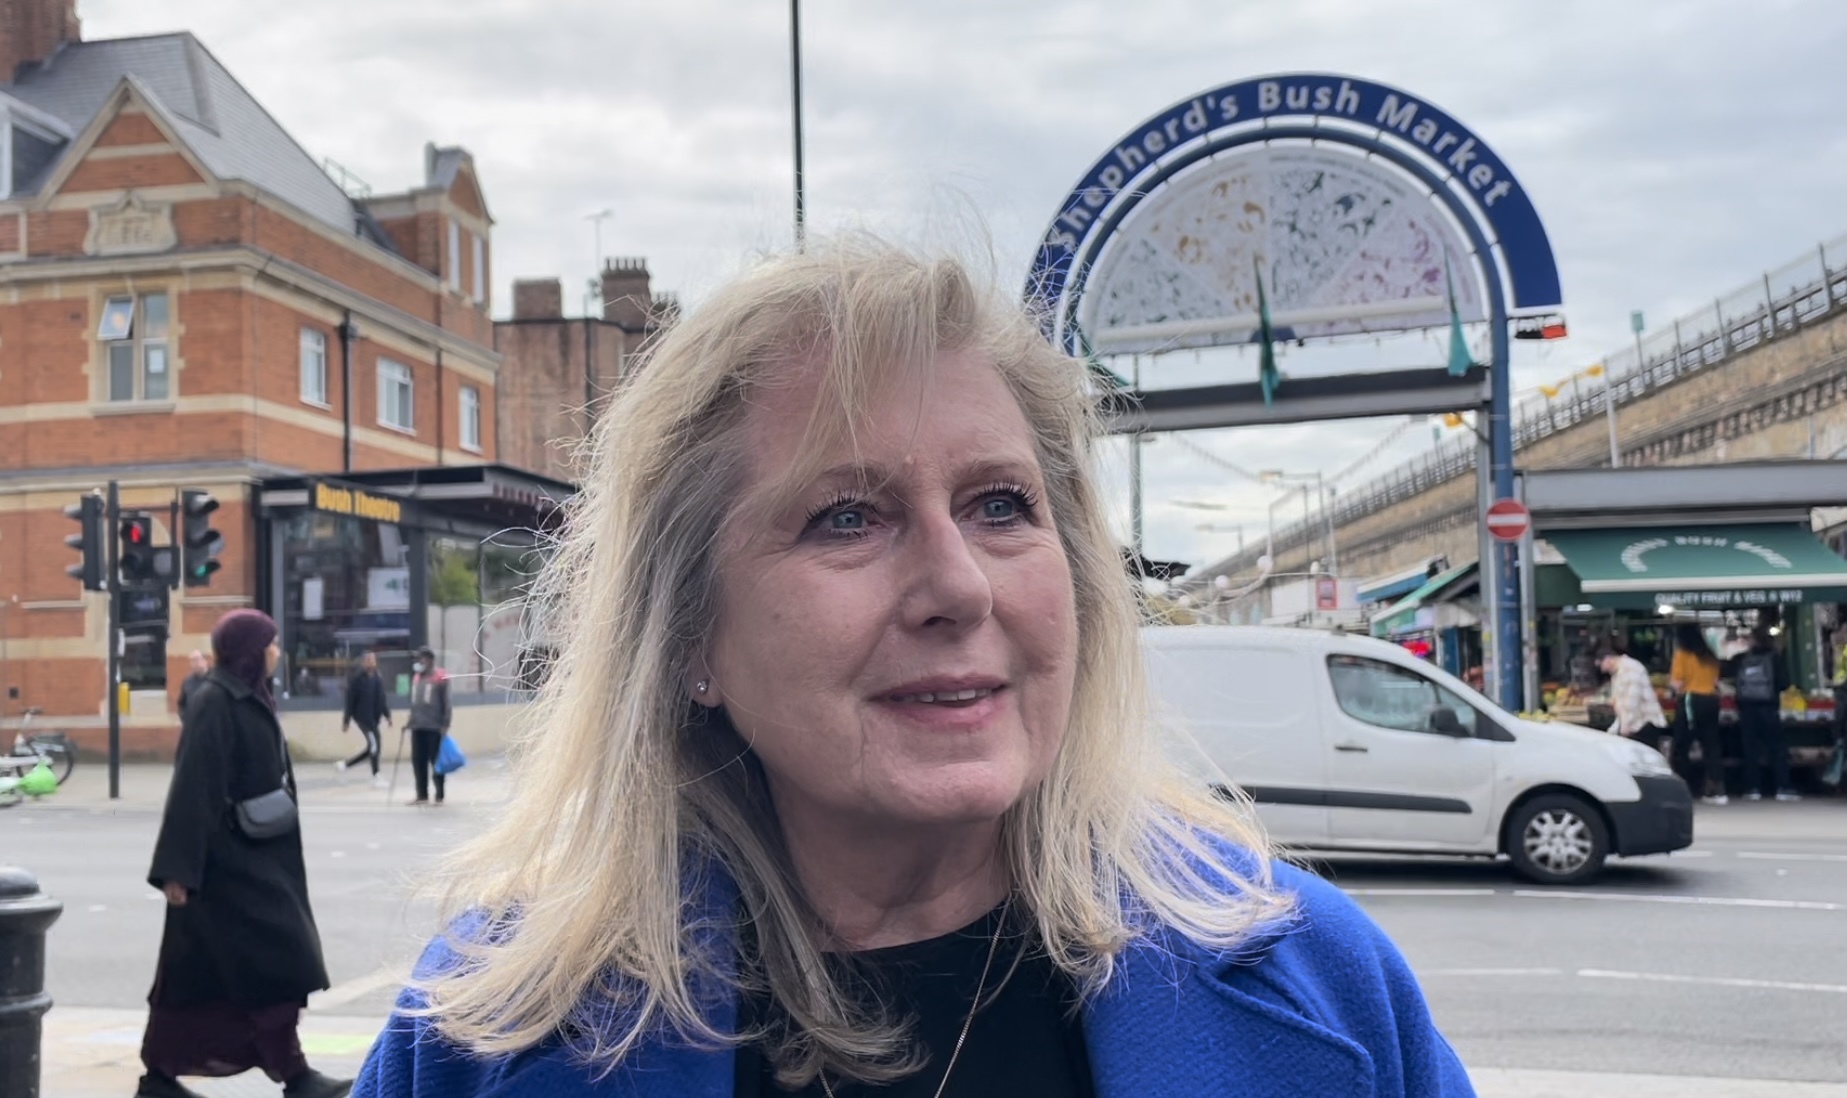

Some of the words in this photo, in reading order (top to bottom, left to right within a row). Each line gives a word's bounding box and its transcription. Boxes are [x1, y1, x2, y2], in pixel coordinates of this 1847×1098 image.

[1049, 95, 1239, 252] Shepherd's
[1258, 80, 1360, 115] Bush
[1376, 94, 1511, 207] Market
[1655, 592, 1699, 605] QUALITY
[1701, 592, 1731, 604] FRUIT
[1744, 591, 1766, 603] VEG
